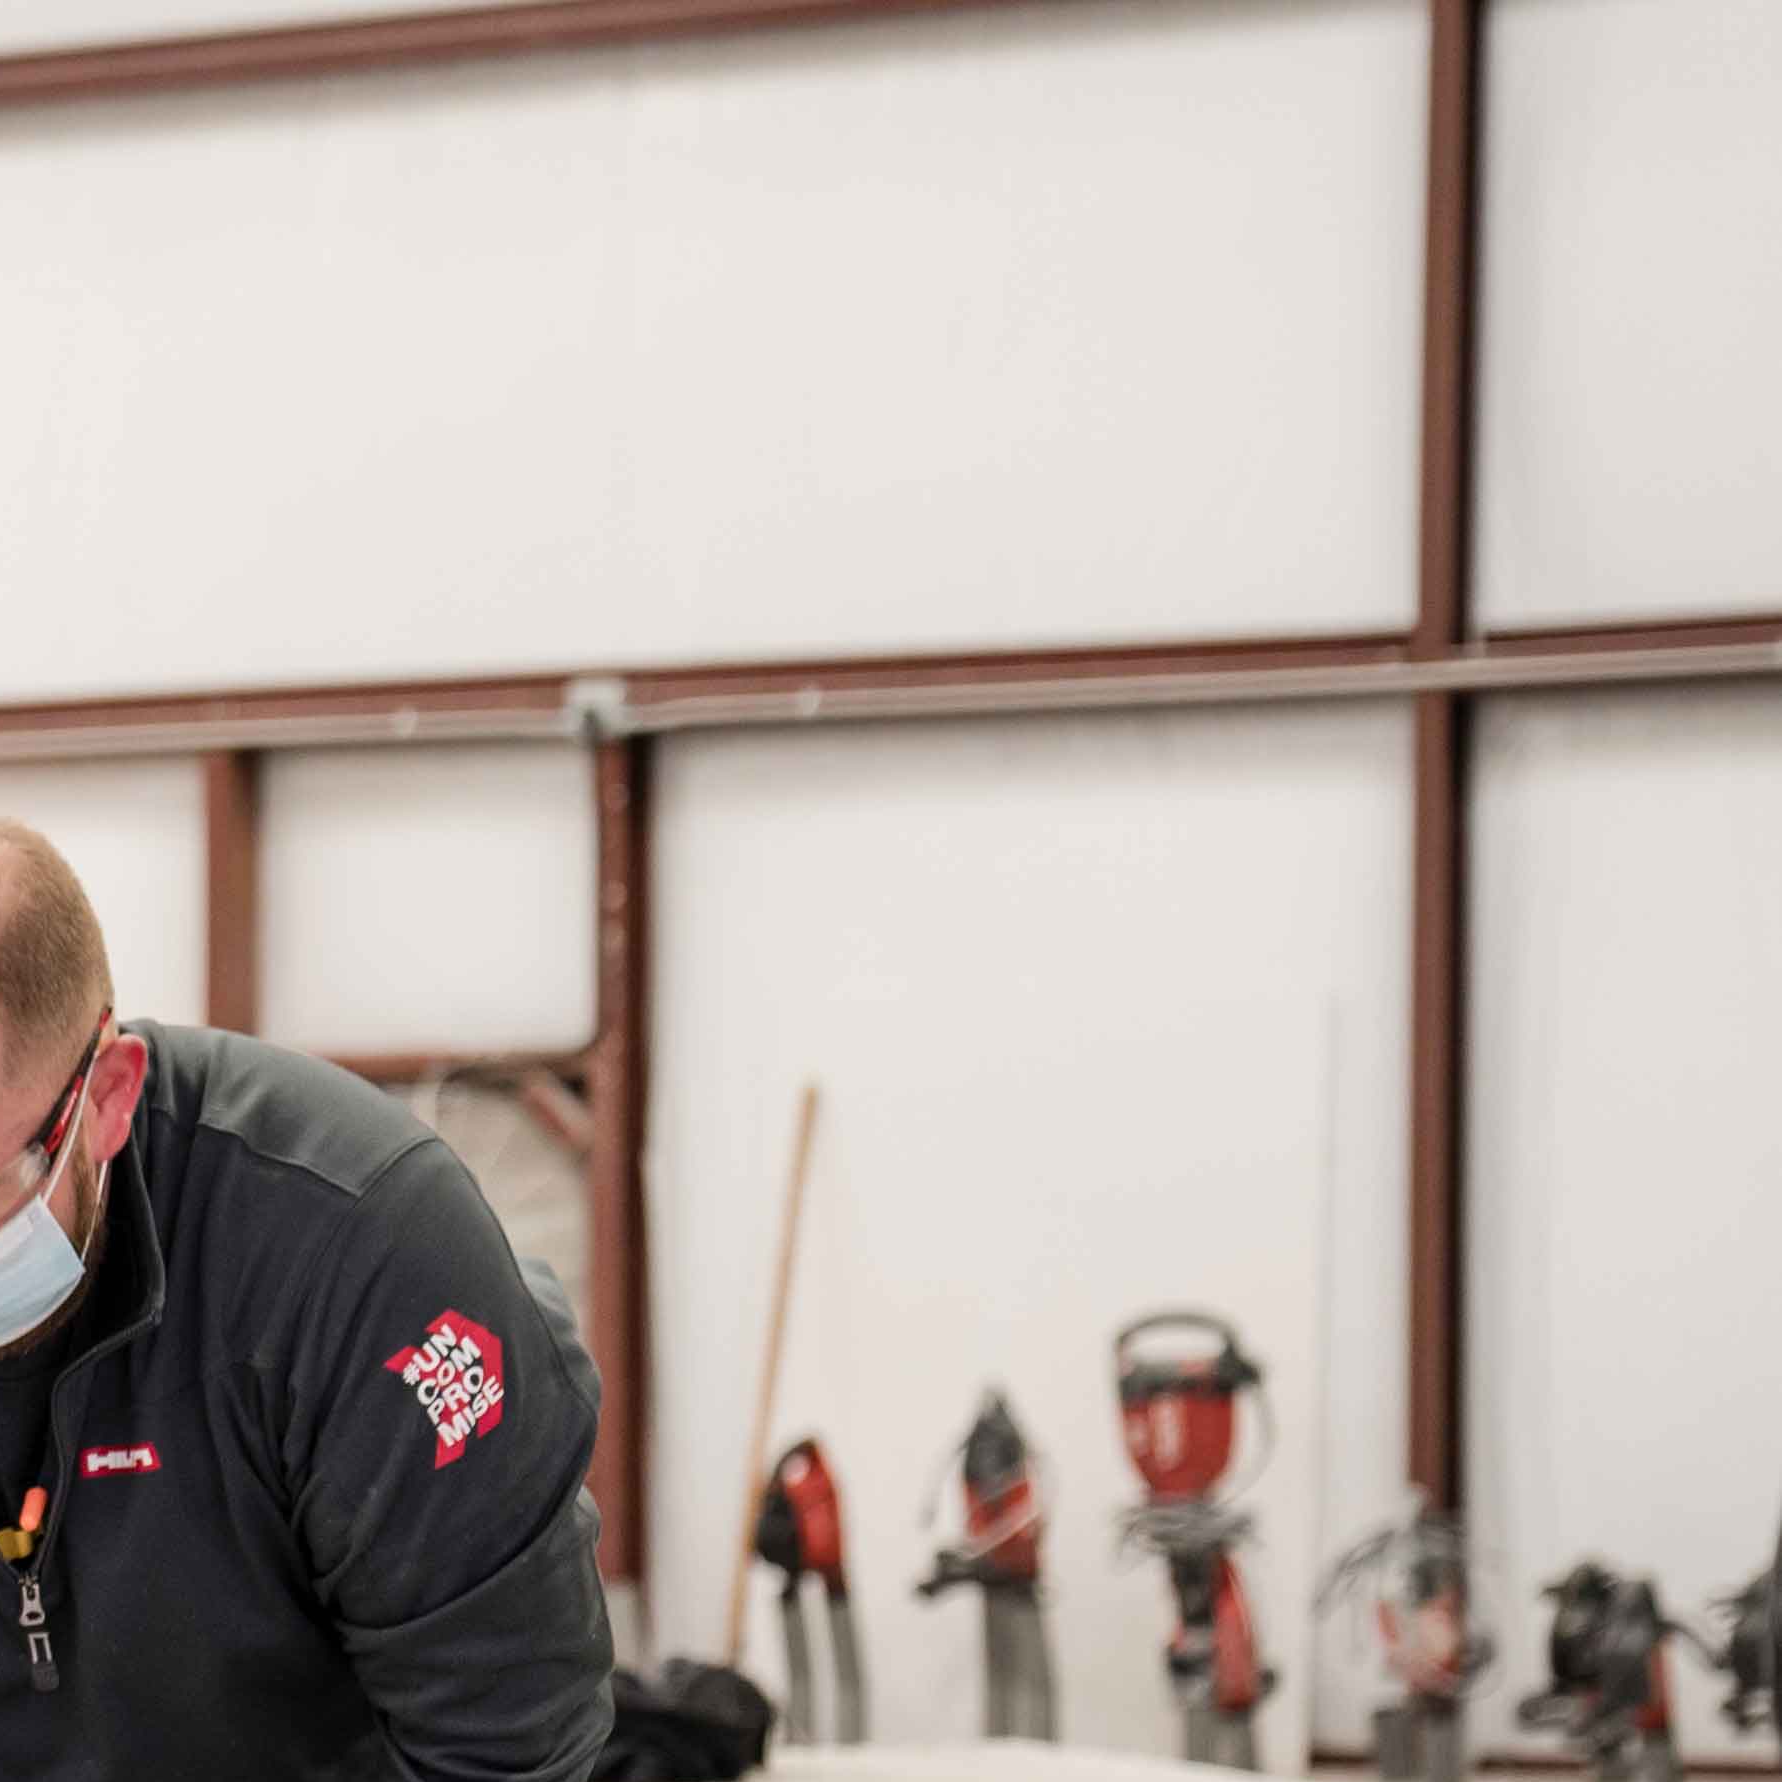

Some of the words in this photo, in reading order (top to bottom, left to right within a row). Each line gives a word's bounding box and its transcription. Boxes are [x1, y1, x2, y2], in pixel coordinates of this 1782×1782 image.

[402, 1323, 457, 1386] #UN
[417, 1336, 481, 1406] COM
[427, 1365, 484, 1425] PRO
[437, 1376, 505, 1447] MISE
